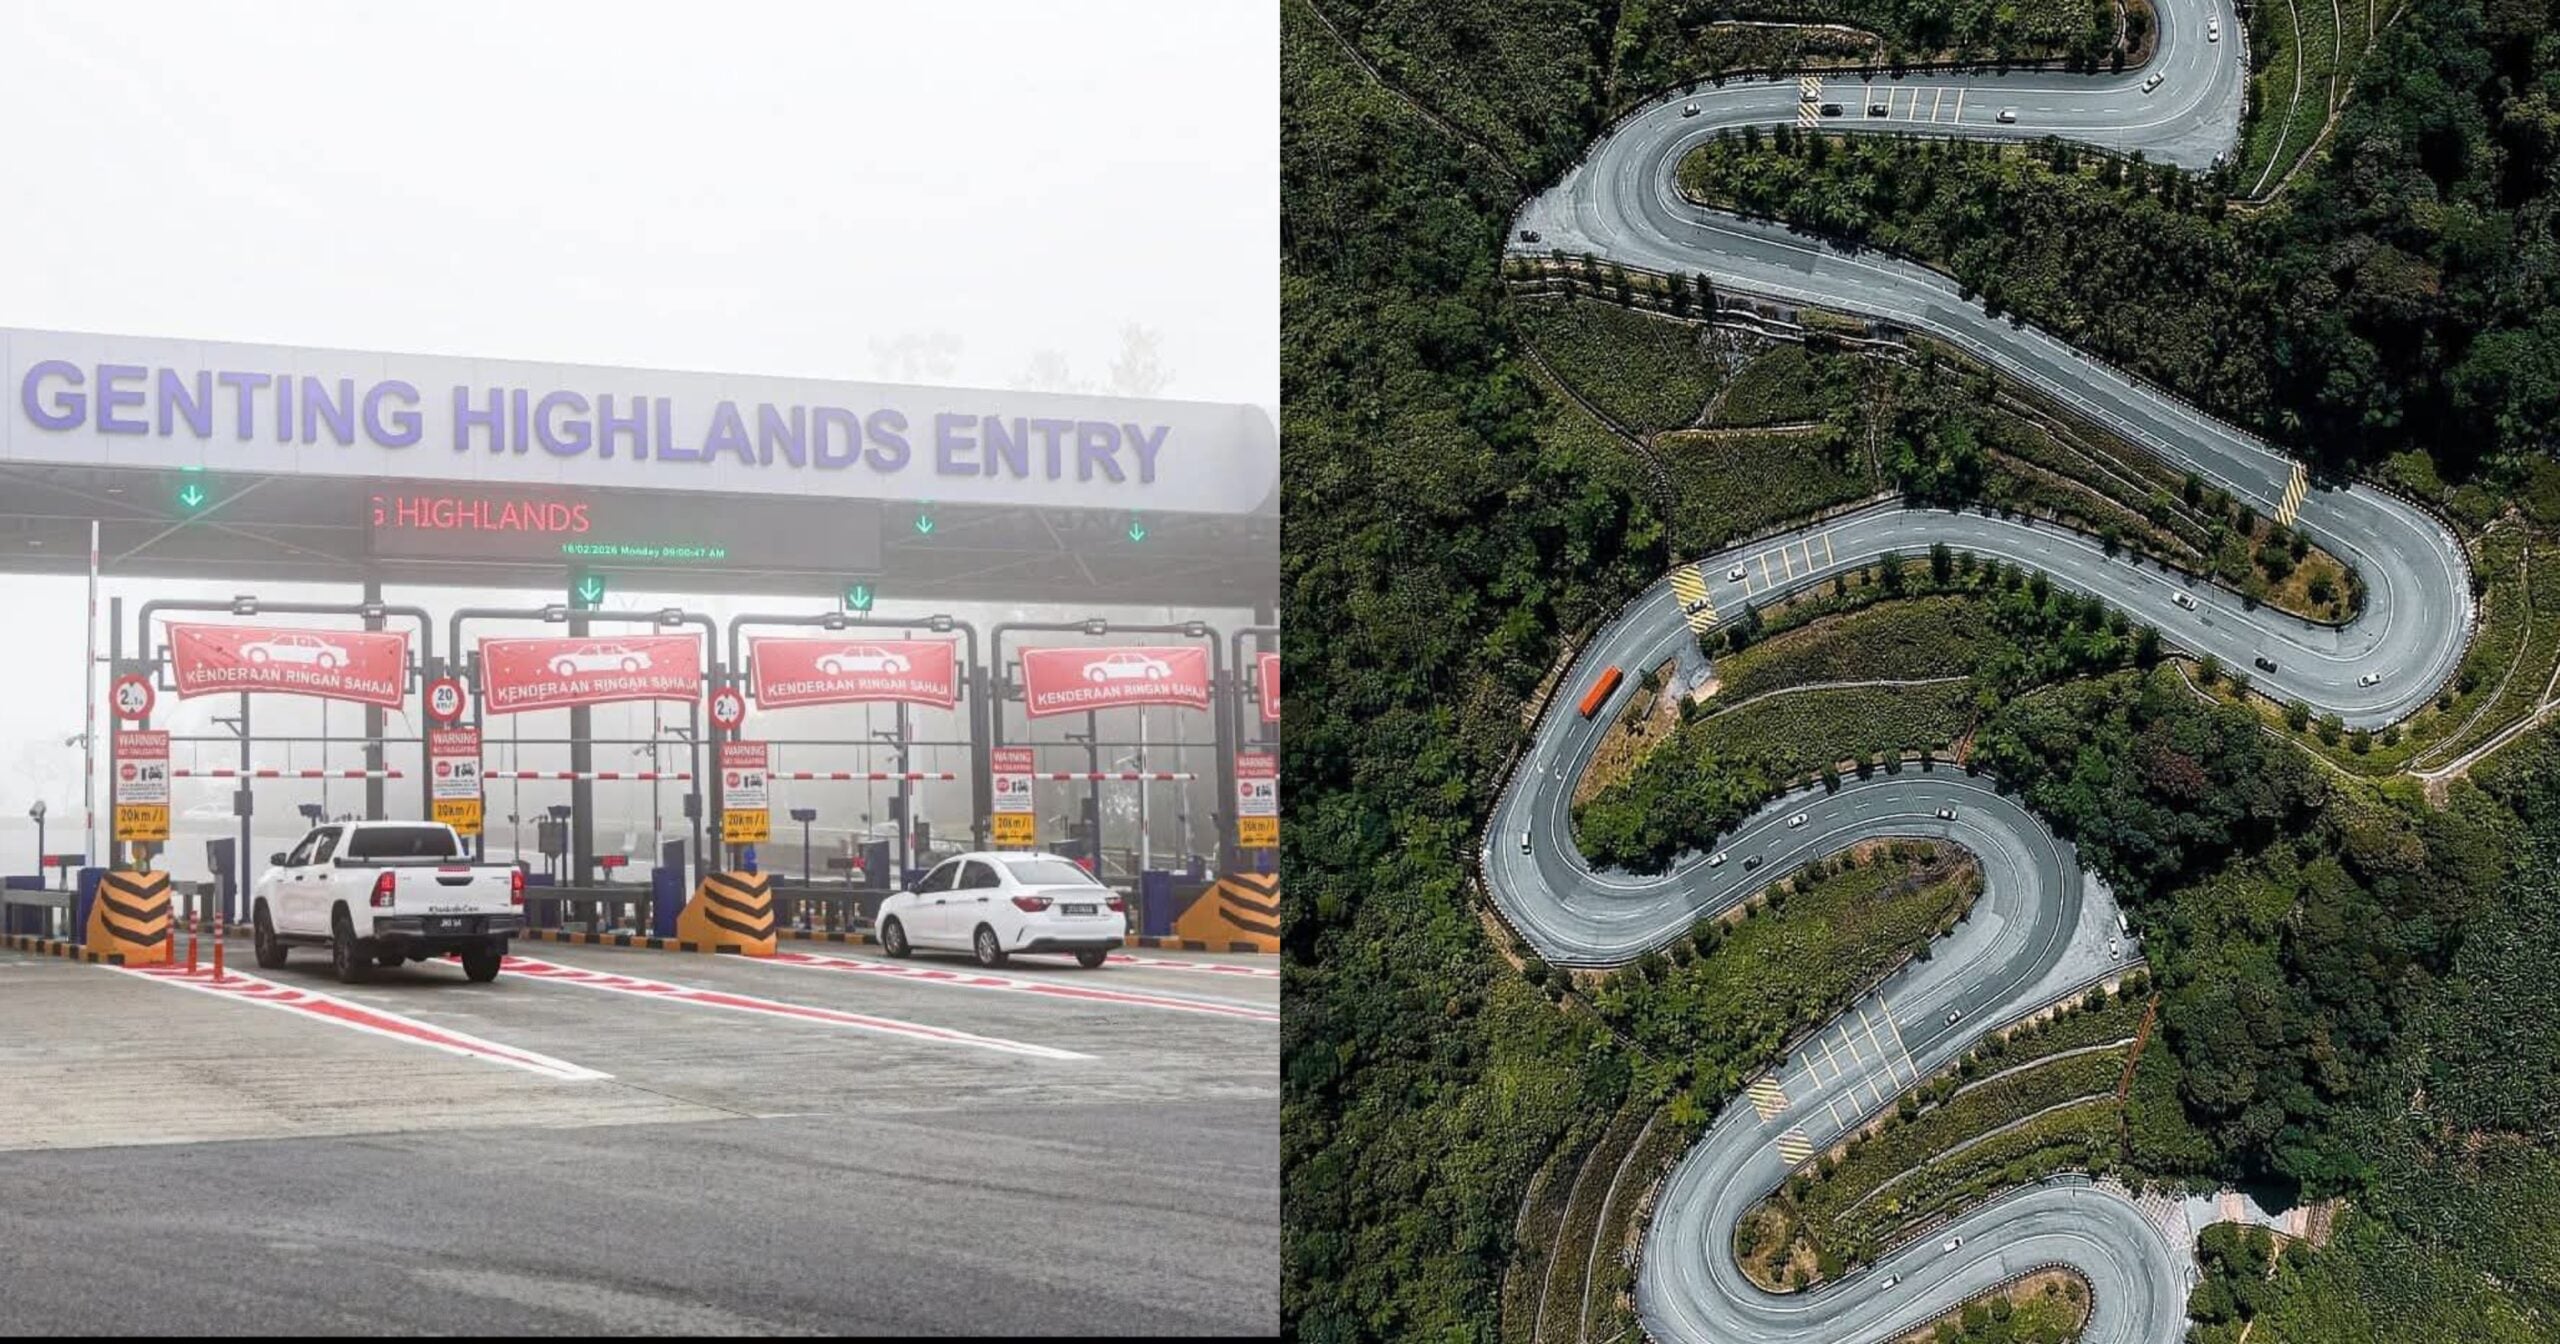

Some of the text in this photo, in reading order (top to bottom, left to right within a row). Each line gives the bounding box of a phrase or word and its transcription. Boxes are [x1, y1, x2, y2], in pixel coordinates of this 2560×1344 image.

[22, 359, 1172, 484] GENTING HIGHLANDS ENTRY
[397, 496, 590, 533] HIGHLANDS
[620, 545, 660, 559] Monday
[708, 548, 725, 559] AM
[186, 667, 395, 696] KENDERAAN RINGAN SAHAJA
[498, 676, 698, 702] KENDERAAN RINGAN SAHAJA
[768, 678, 948, 697] KENDERAAN RINGAN SAHAJA
[437, 687, 454, 701] 20
[1038, 683, 1206, 705] KENDERAAN RINGAN SAHAJA
[119, 733, 168, 746] WARNING
[432, 732, 477, 745] WARNING
[723, 744, 765, 757] WARNING
